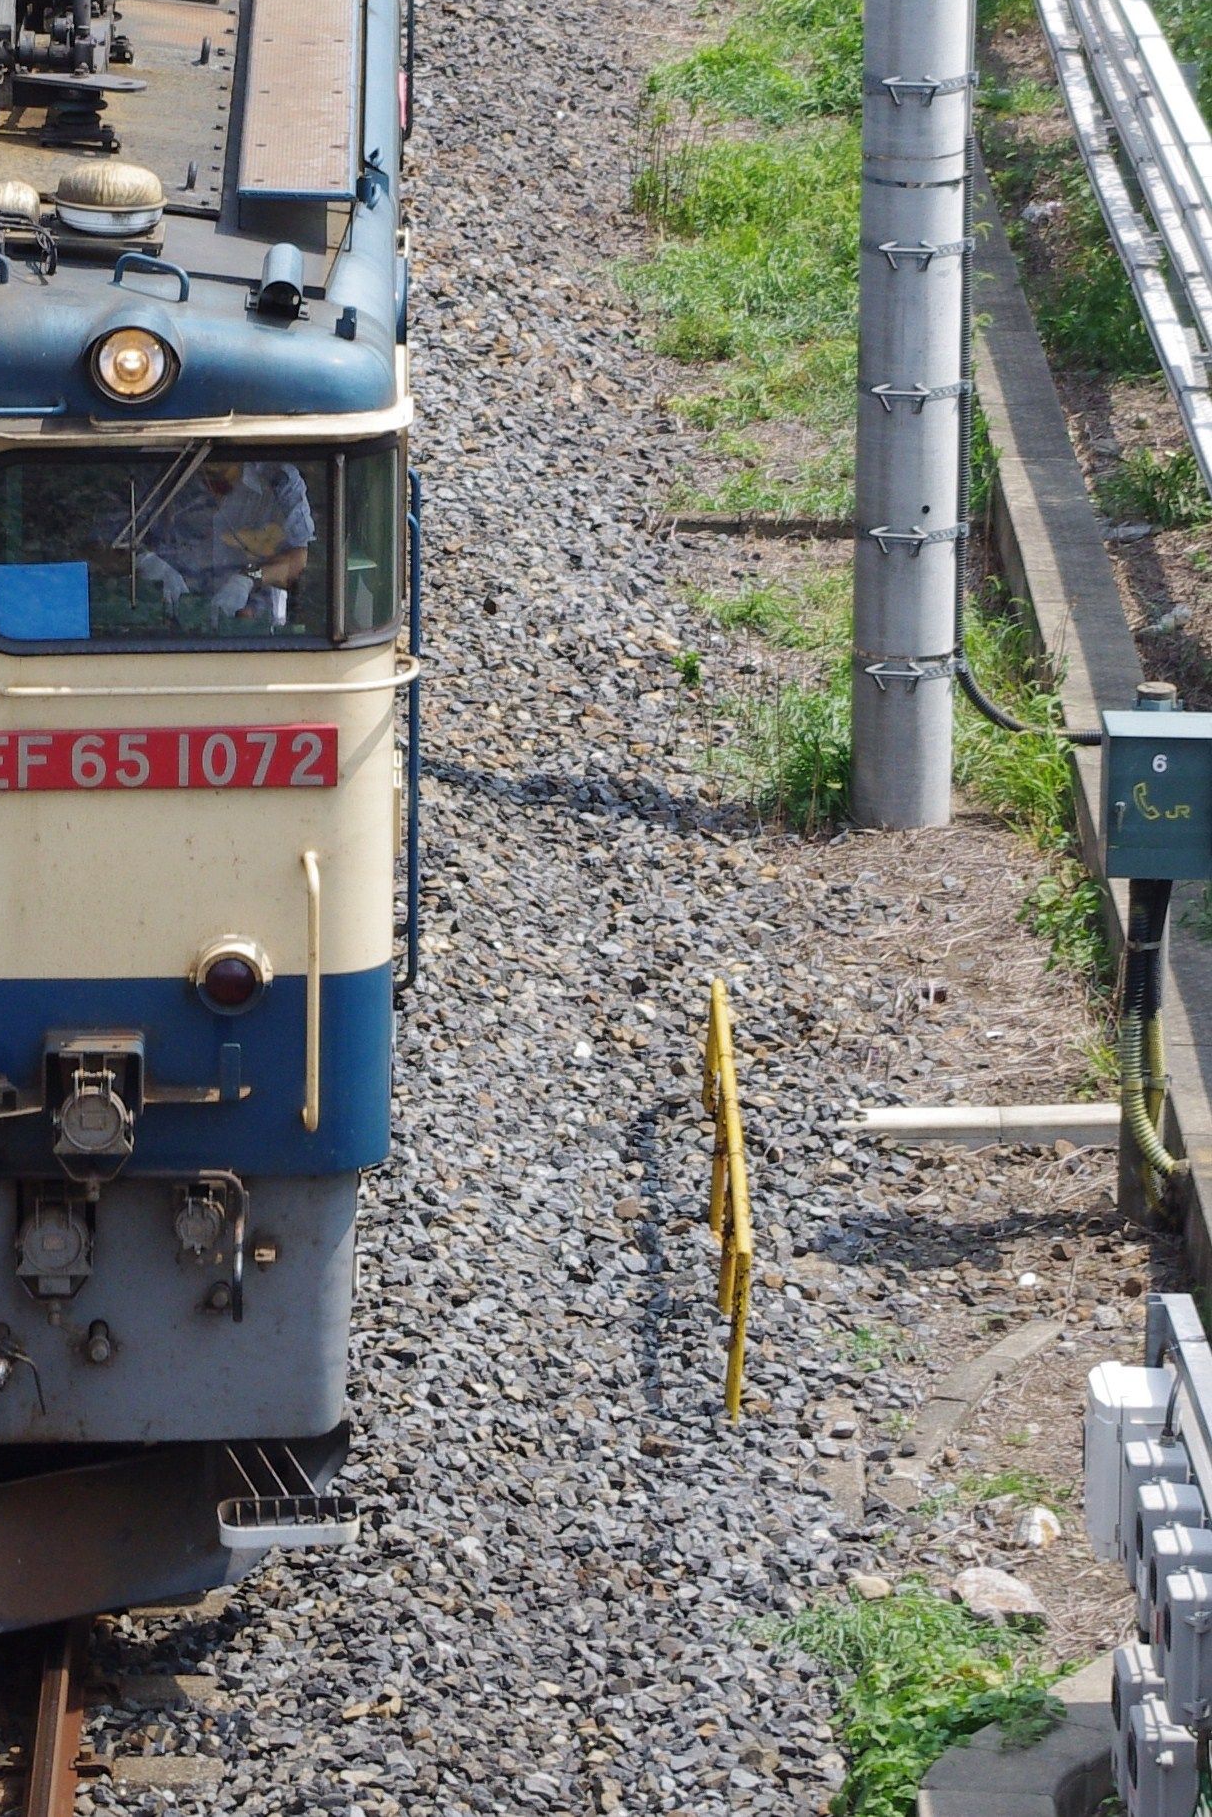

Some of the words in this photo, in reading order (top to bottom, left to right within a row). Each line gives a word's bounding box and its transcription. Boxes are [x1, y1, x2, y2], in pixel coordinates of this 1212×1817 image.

[71, 733, 150, 788] 65
[178, 732, 325, 787] 1072
[1152, 753, 1168, 773] 6
